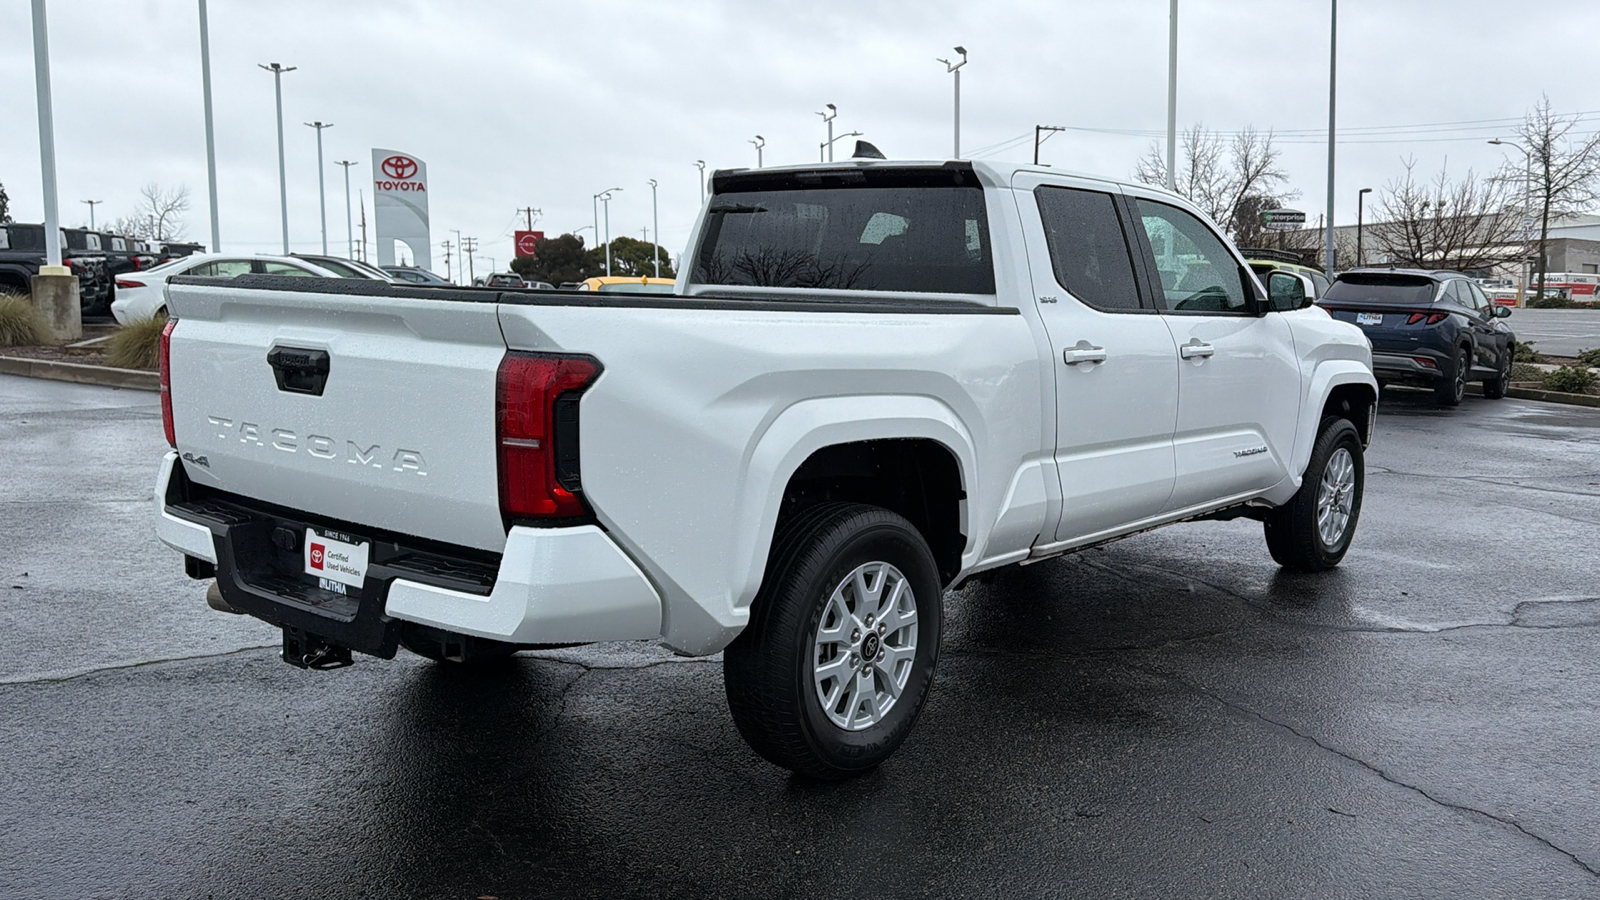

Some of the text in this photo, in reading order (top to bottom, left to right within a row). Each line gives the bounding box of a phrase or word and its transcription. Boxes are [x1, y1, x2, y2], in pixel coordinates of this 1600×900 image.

[375, 181, 426, 192] TOYOTA
[1266, 213, 1305, 222] enterprise
[281, 354, 310, 367] TOYOTA
[207, 415, 428, 476] TACOMA
[324, 529, 339, 540] SINCE
[327, 550, 349, 562] Certified
[326, 561, 361, 576] Used Vehicles
[325, 579, 347, 595] LITHIA
